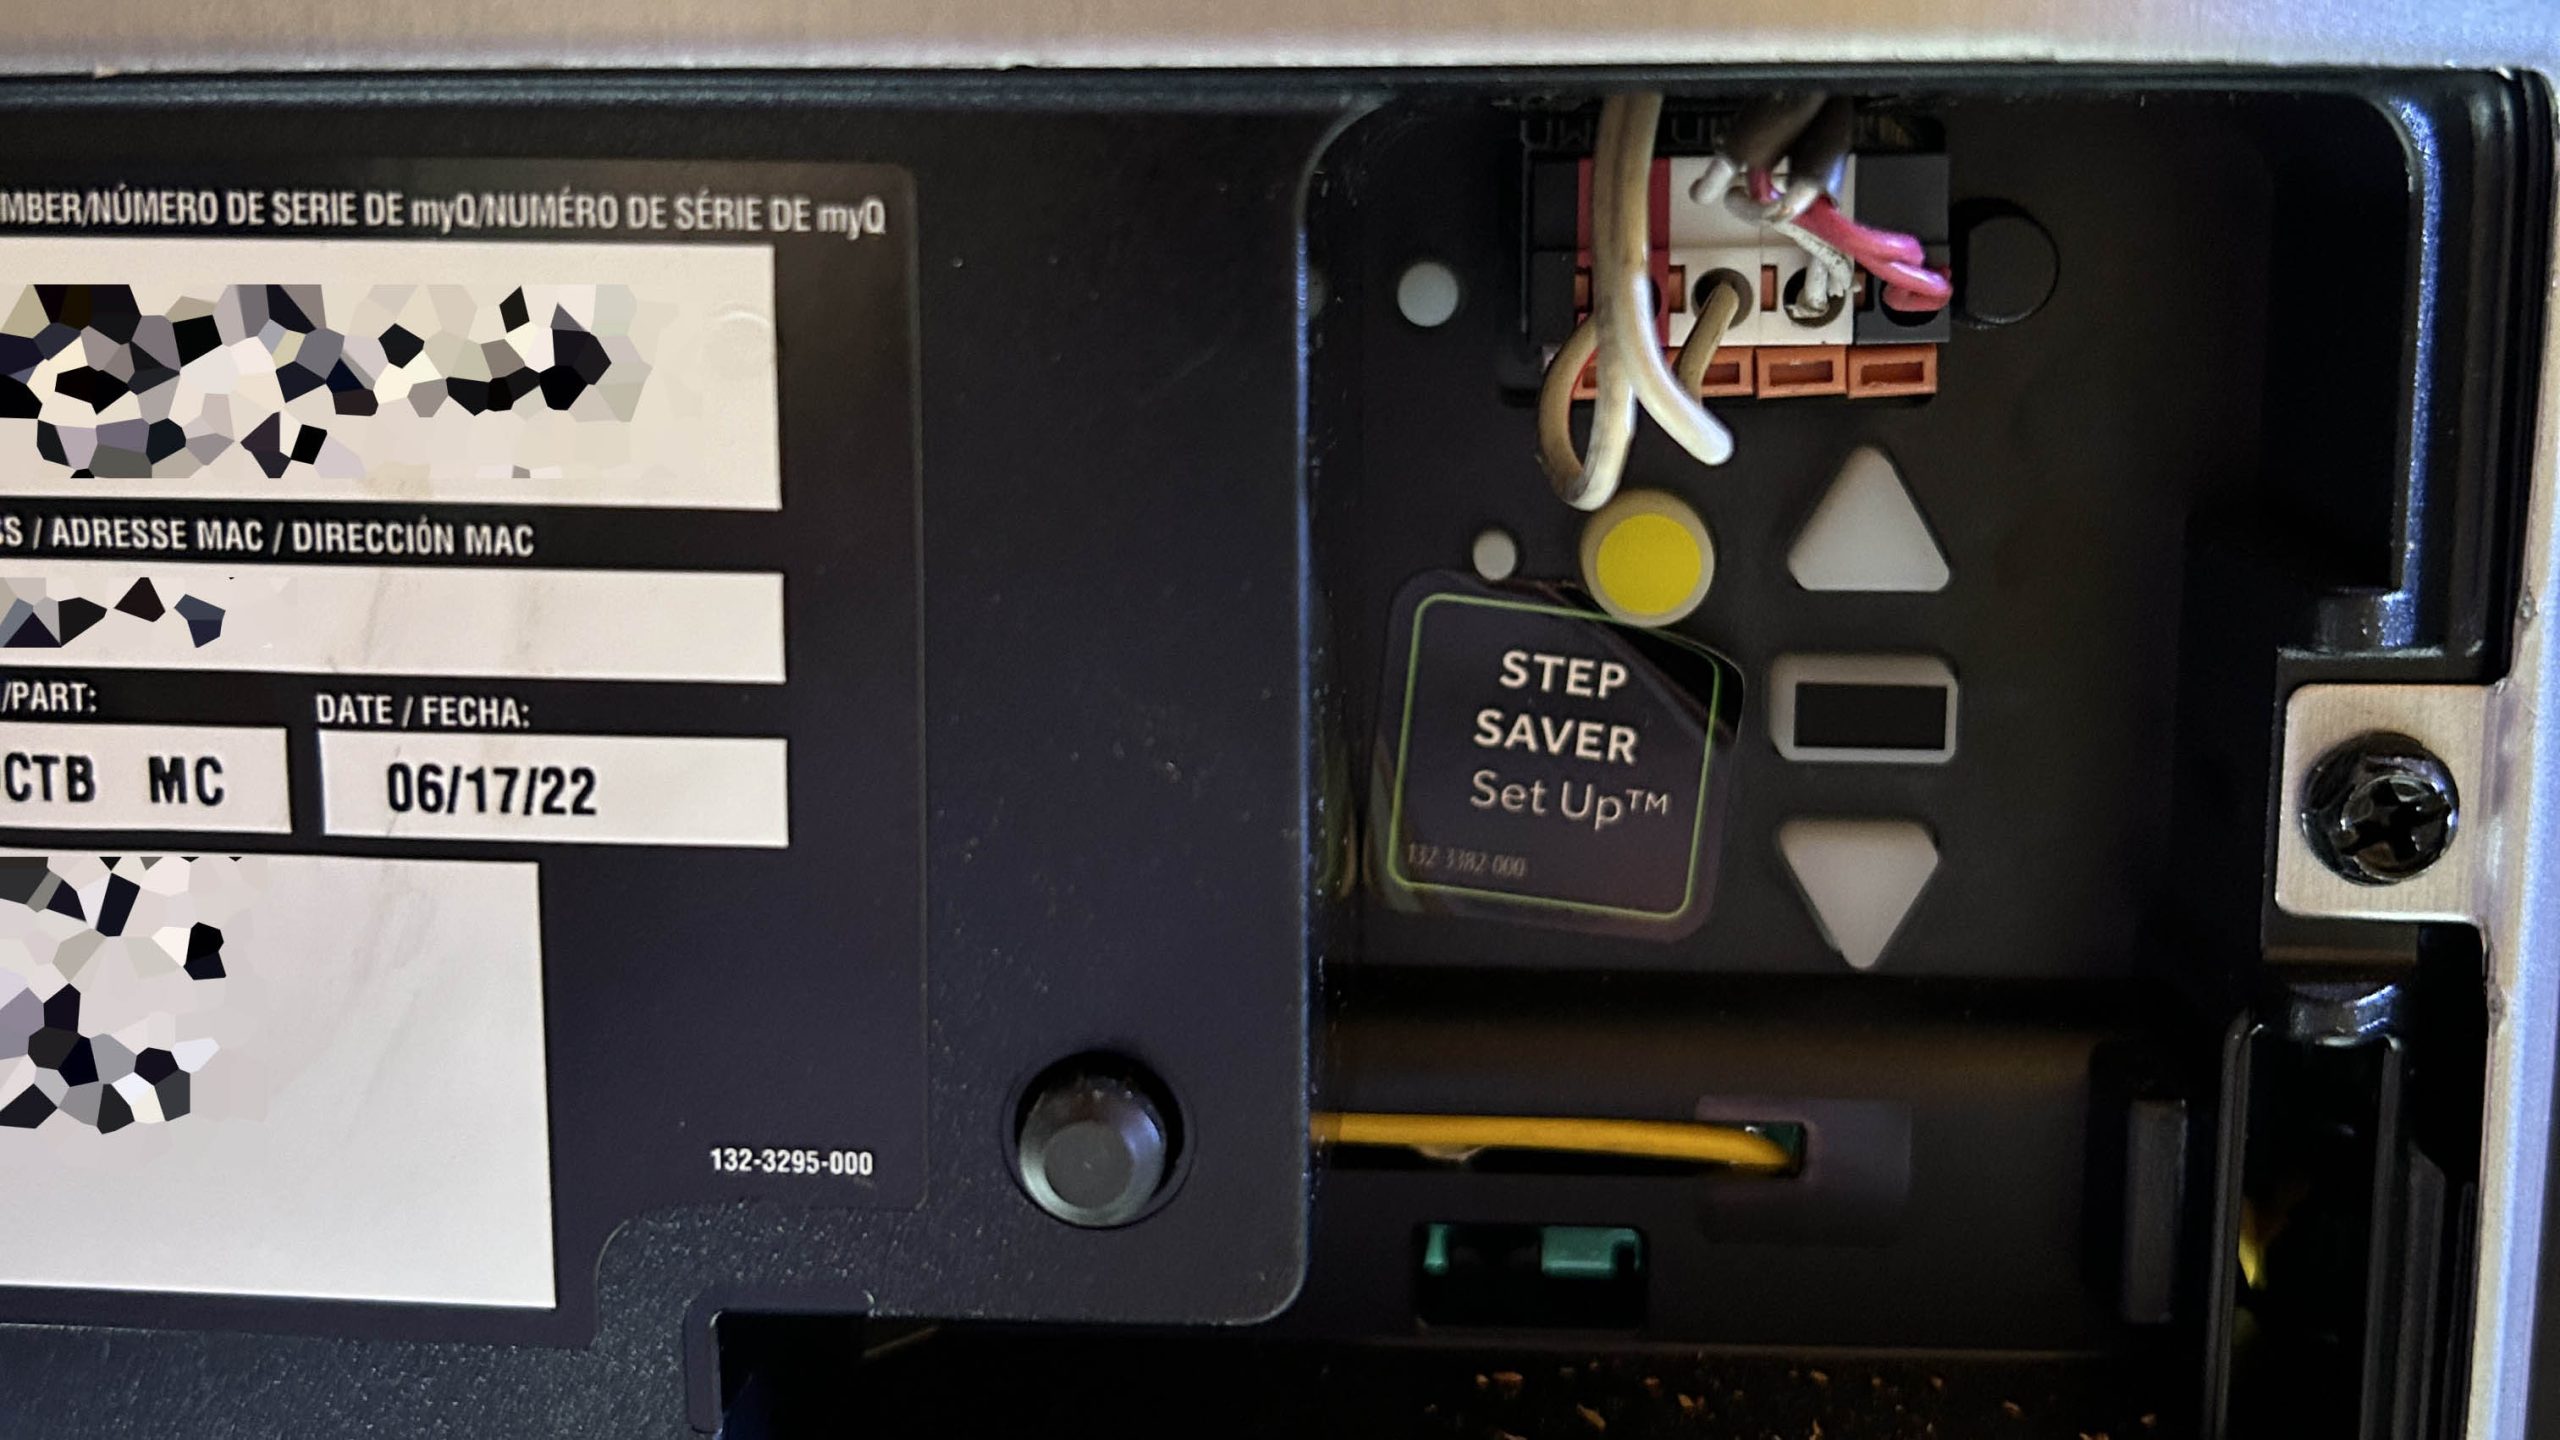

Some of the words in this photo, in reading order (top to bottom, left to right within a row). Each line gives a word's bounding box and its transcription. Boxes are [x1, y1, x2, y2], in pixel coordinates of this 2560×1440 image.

[226, 191, 265, 226] DE
[272, 191, 358, 226] SERIE
[365, 192, 403, 227] DE
[626, 196, 667, 230] DE
[674, 190, 762, 231] SÉRIE
[769, 199, 811, 232] DE
[816, 199, 886, 240] myQ
[32, 516, 43, 550] /
[52, 517, 188, 549] ADRESSE
[196, 519, 264, 552] MAC
[272, 521, 284, 556] /
[292, 514, 455, 554] DIRECCIÓN
[464, 524, 534, 557] MAC
[1, 681, 97, 713] /PART:
[1499, 650, 1628, 699] STEP
[315, 693, 394, 724] DATE
[401, 696, 414, 728] /
[420, 696, 530, 728] FECHA:
[1473, 708, 1638, 764] SAVER
[4, 752, 96, 802] CTB
[148, 755, 224, 806] MC
[387, 762, 597, 816] 06/17/22
[1470, 769, 1548, 814] Set
[709, 1147, 874, 1176] 132-3295-000
